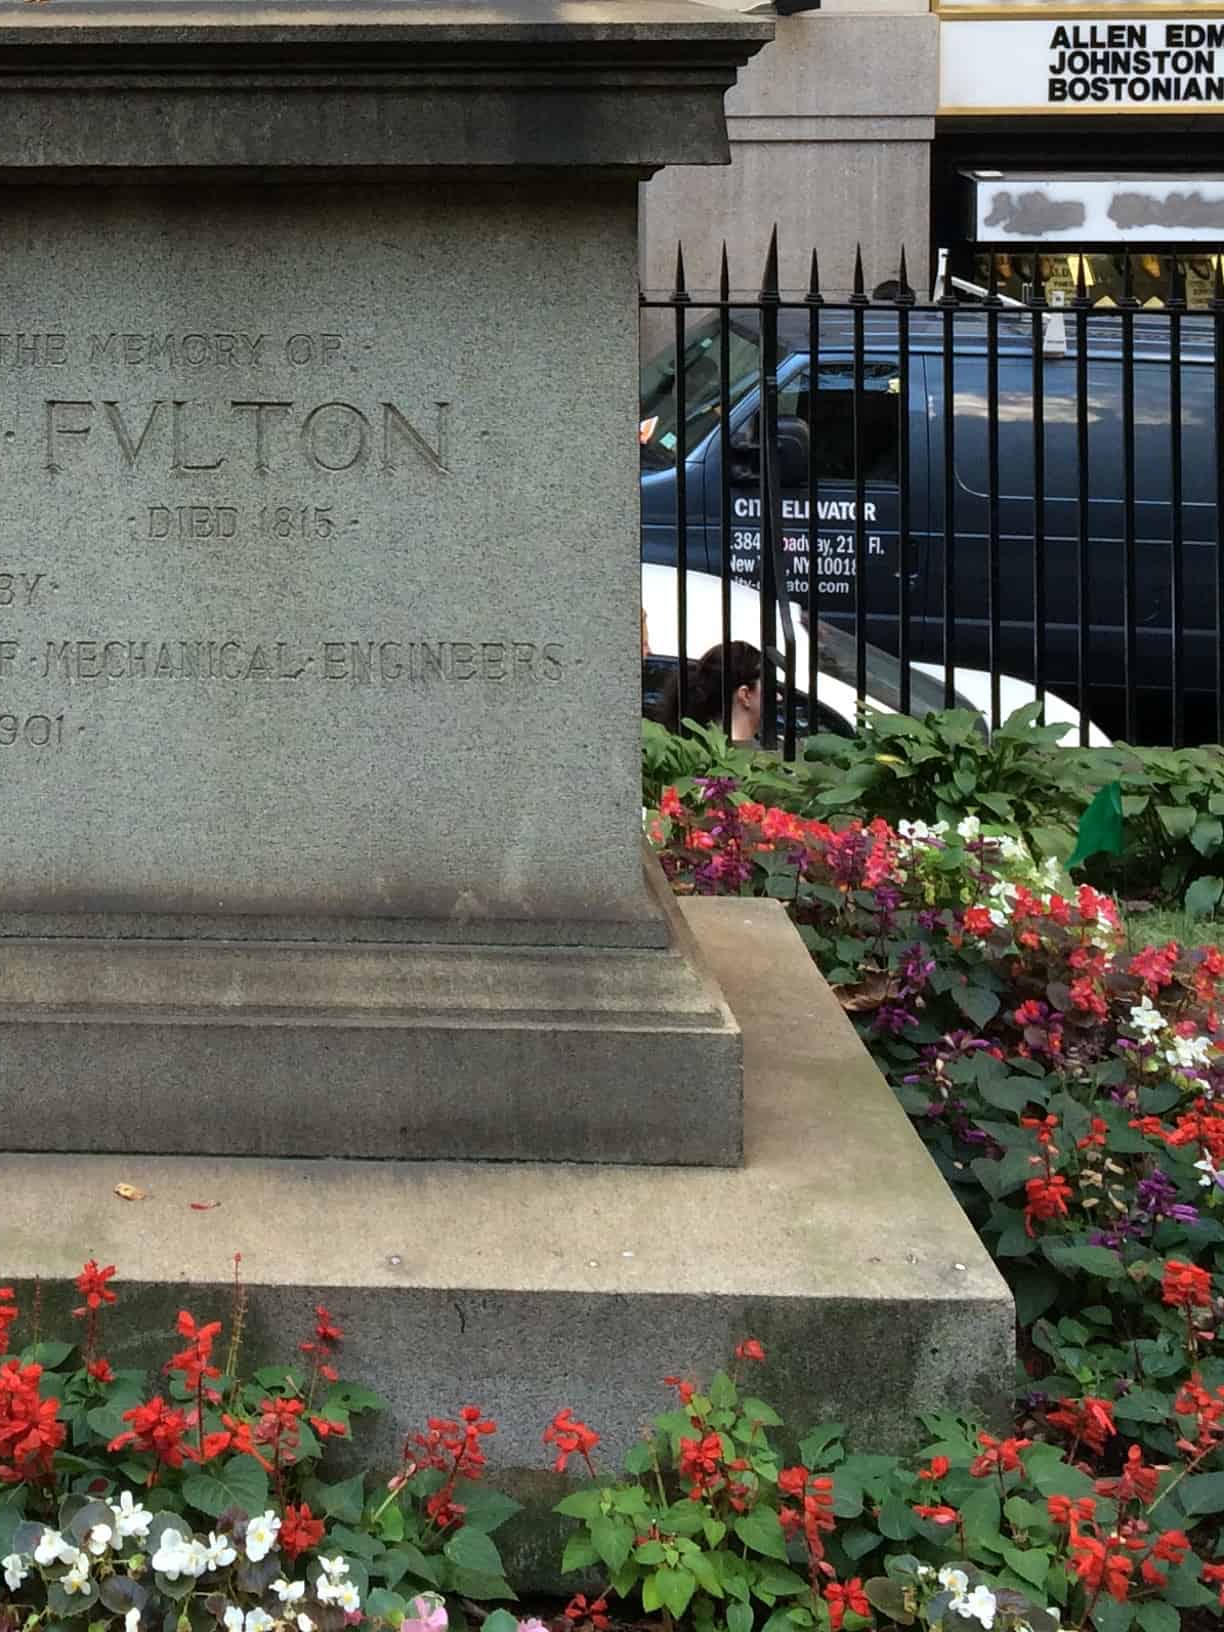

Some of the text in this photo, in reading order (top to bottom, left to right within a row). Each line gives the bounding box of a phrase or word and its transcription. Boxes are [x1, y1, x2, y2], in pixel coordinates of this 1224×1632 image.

[1049, 25, 1147, 49] ALLEN
[1049, 50, 1215, 75] JOHNSTON
[1048, 77, 1224, 102] BOSTONIAN
[88, 332, 271, 368] MEMORY
[285, 332, 346, 368] OF
[42, 399, 453, 475] FVLTON
[734, 498, 760, 517] CIT
[146, 504, 334, 540] DIED 1815
[730, 531, 761, 551] 384
[43, 640, 305, 681] MECHANICAL
[323, 641, 566, 682] ENGINEERS
